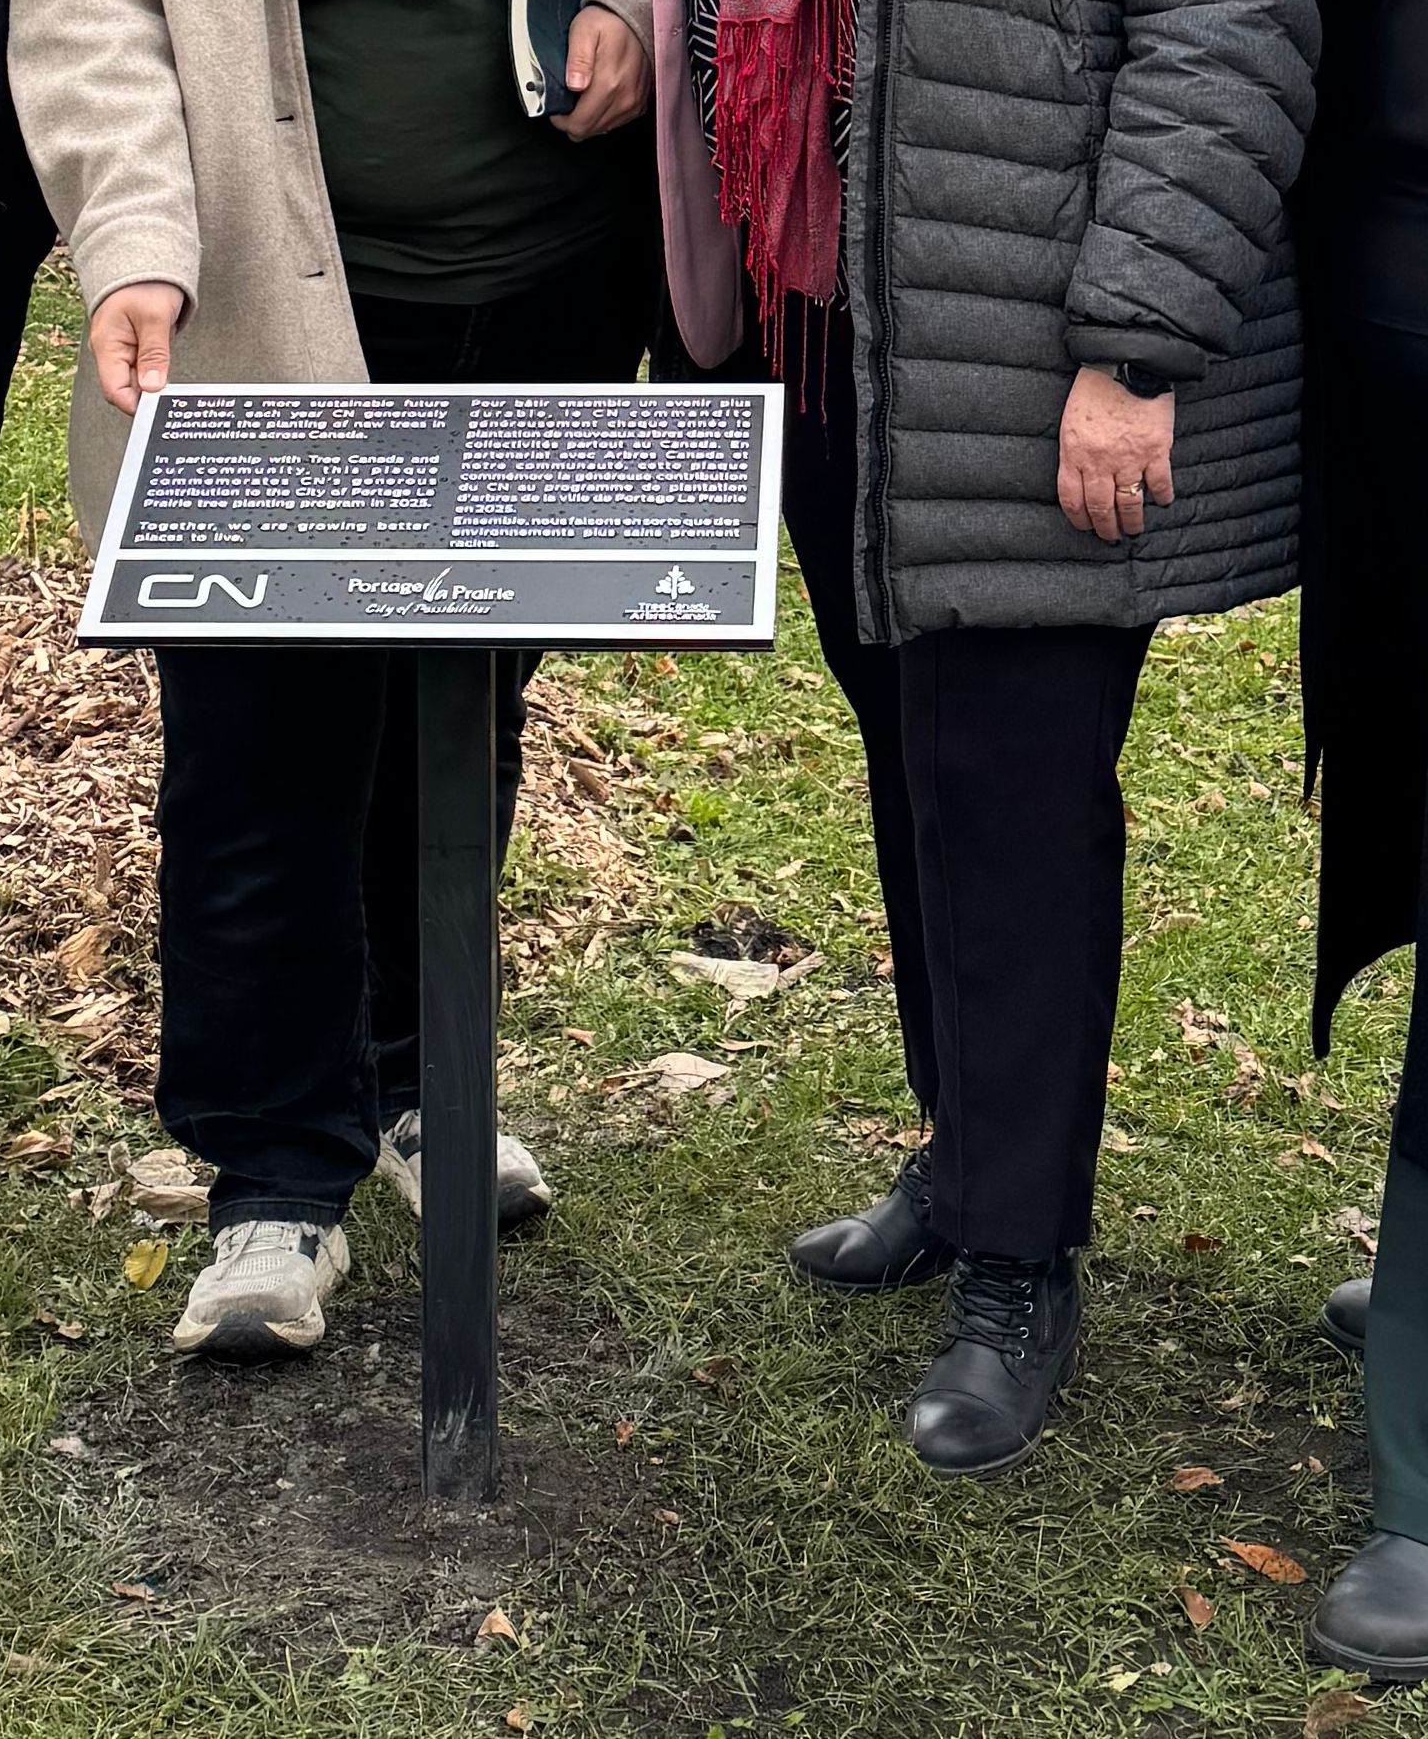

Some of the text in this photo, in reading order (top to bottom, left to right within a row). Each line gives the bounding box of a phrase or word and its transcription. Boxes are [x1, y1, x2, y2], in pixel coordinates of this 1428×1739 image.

[171, 398, 450, 408] To build a more sustainable future
[471, 399, 507, 408] Pour
[557, 398, 631, 408] ensemble
[638, 399, 658, 408] un
[665, 398, 712, 408] avenir
[719, 398, 751, 408] plus
[245, 409, 281, 418] each
[289, 410, 324, 420] year
[332, 409, 355, 418] CN
[363, 409, 448, 420] generously
[564, 408, 582, 418] le
[592, 408, 619, 418] CN
[629, 409, 752, 418] commandite
[164, 419, 446, 430] sponsors the planting of new trees in
[606, 419, 669, 429] chaque
[736, 419, 751, 428] la
[161, 430, 368, 440] communities across Canada.
[465, 429, 750, 440] plantation de nouveaux arbres dans des
[566, 439, 624, 450] partout
[632, 440, 652, 449] au
[659, 439, 722, 449] Canada.
[729, 439, 750, 449] En
[154, 454, 440, 465] In partnership with Tree Canada and
[462, 450, 749, 461] partenariat avec Arbres Canada et
[152, 467, 185, 475] our
[322, 465, 360, 475] this
[370, 465, 439, 476] plaque
[461, 461, 507, 470] notre
[637, 461, 682, 470] cette
[690, 460, 749, 471] plaque
[149, 476, 289, 486] commemorates
[351, 477, 437, 487] generous
[557, 471, 571, 481] la
[653, 471, 748, 481] contribution
[146, 487, 435, 498] contribution to the City of Portage La
[458, 482, 748, 493] du CN au programme de plantation
[520, 493, 541, 503] de
[542, 493, 557, 503] la
[558, 492, 591, 503] ville
[590, 493, 613, 503] de
[614, 493, 676, 504] Portage
[677, 493, 698, 503] La
[698, 493, 747, 503] Prairie
[143, 498, 193, 508] Prairie
[197, 499, 229, 508] tree
[232, 498, 296, 509] planting
[299, 499, 366, 510] program
[370, 498, 385, 508] in
[454, 505, 475, 514] en
[139, 521, 431, 532] Together, we are growing better
[531, 517, 568, 526] nous
[568, 516, 622, 526] faisons
[622, 517, 642, 526] en
[639, 517, 683, 526] sorte
[680, 517, 713, 528] que
[713, 516, 740, 526] des
[134, 532, 184, 543] places
[190, 532, 208, 542] to
[451, 527, 740, 538] environnements plus sains prennent
[137, 573, 269, 609] CN
[348, 578, 424, 595] Portage
[452, 585, 515, 601] Prairie
[365, 603, 395, 618] City
[396, 602, 414, 616] of
